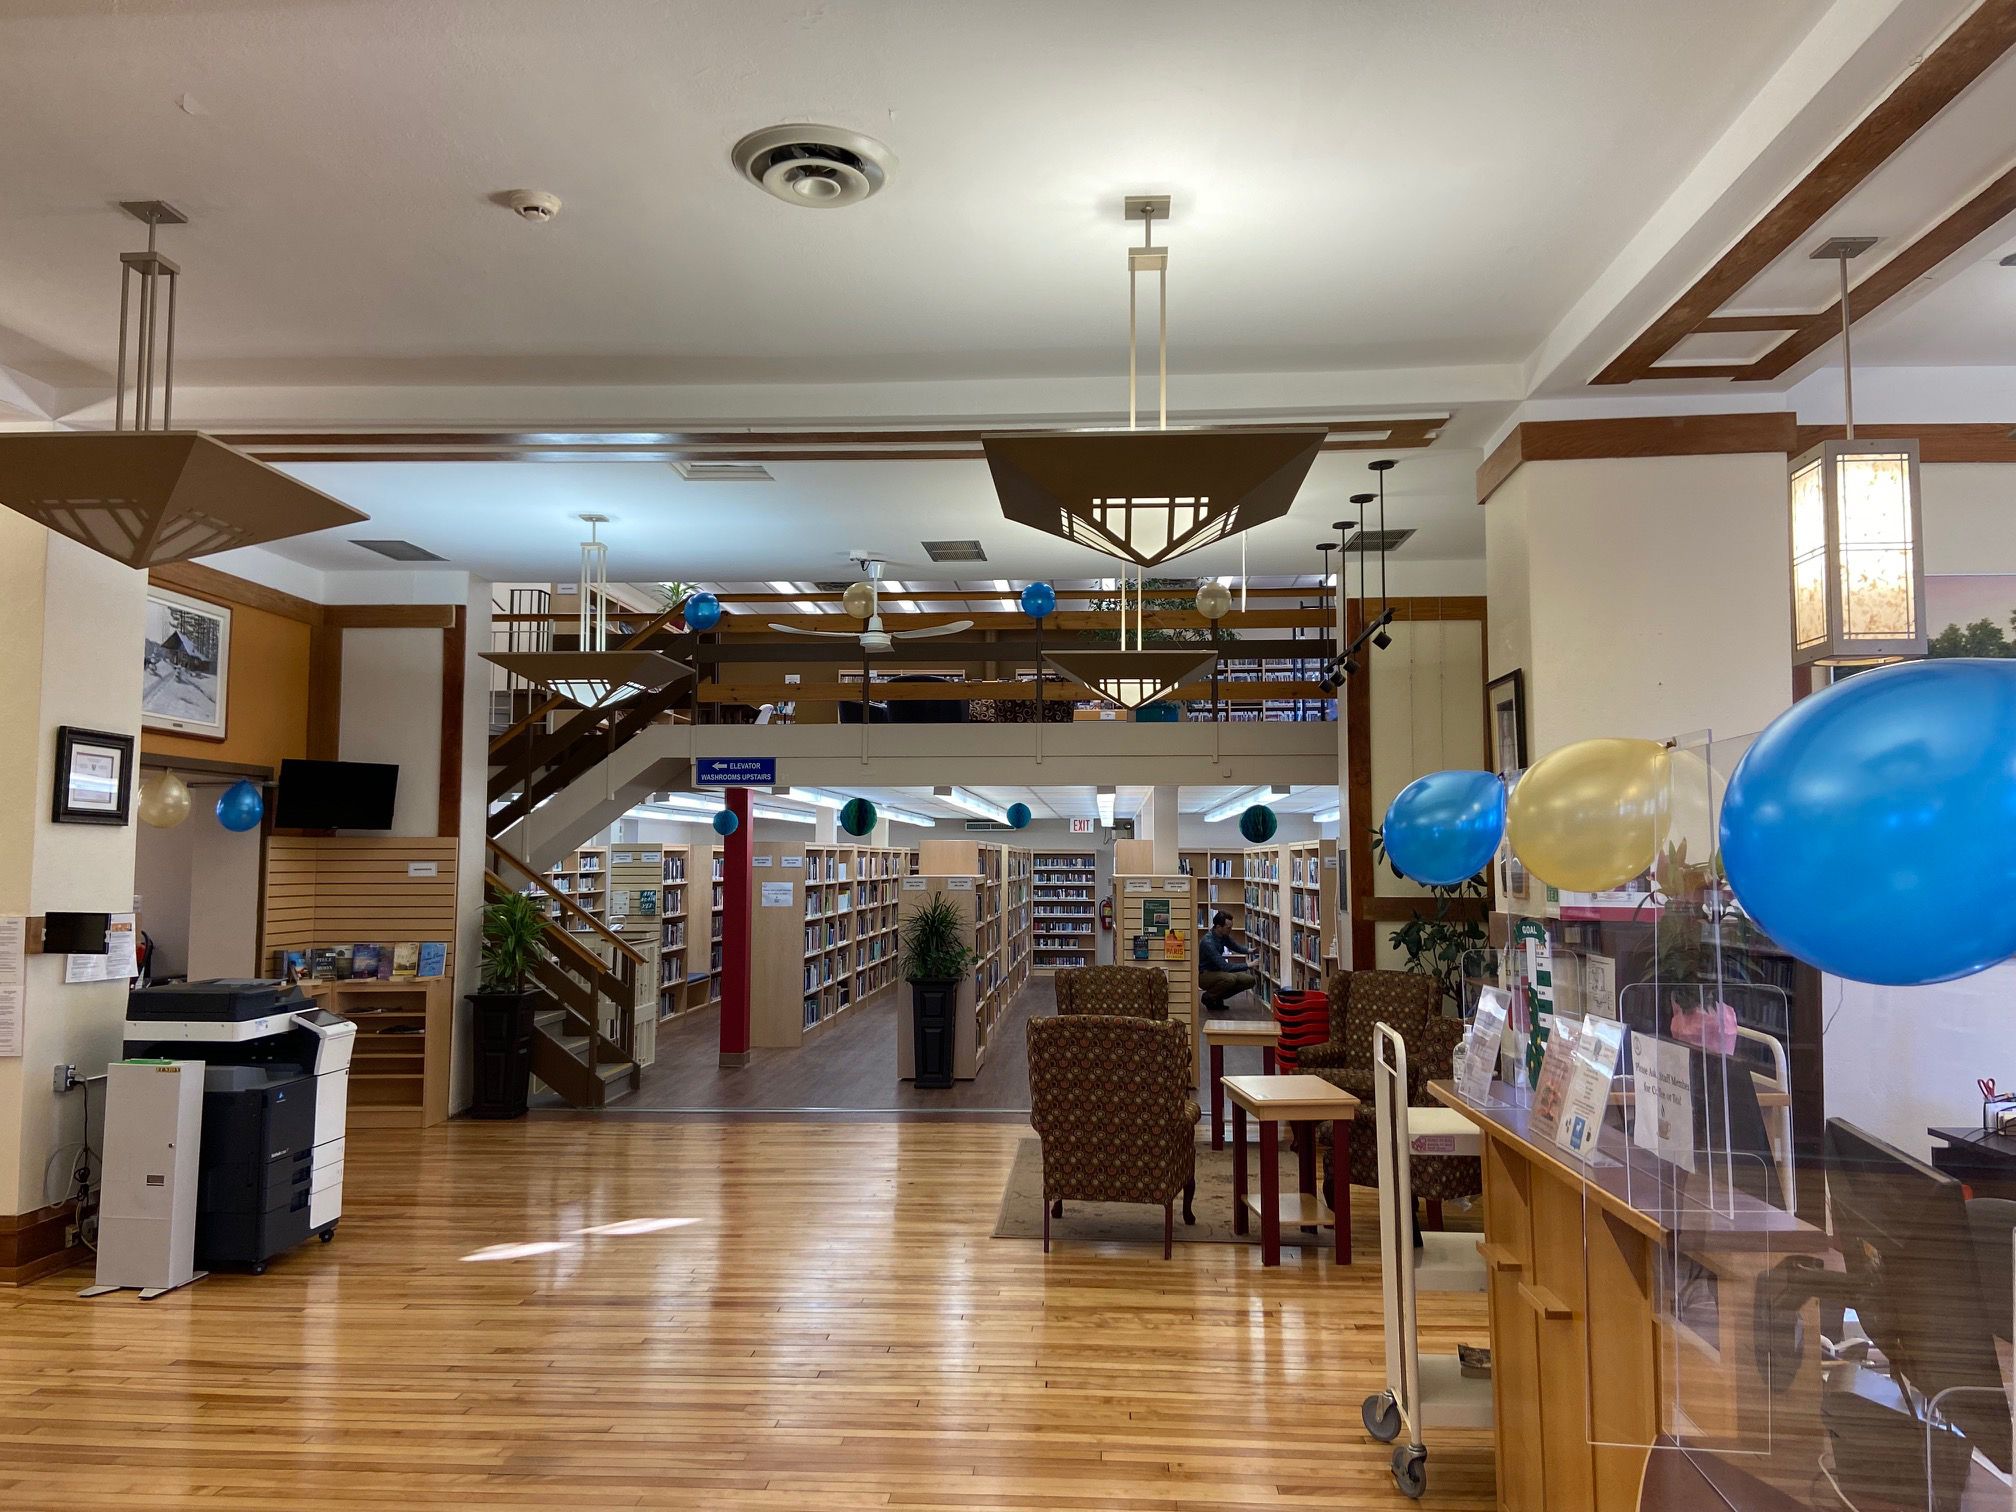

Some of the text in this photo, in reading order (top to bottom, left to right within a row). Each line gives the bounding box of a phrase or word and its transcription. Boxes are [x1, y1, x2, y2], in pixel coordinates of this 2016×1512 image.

[729, 762, 761, 770] ELEVATOR
[701, 773, 741, 781] WASHROOMS
[1073, 819, 1090, 831] EXIT
[1521, 925, 1537, 935] GOAL
[1166, 947, 1184, 955] PARIS
